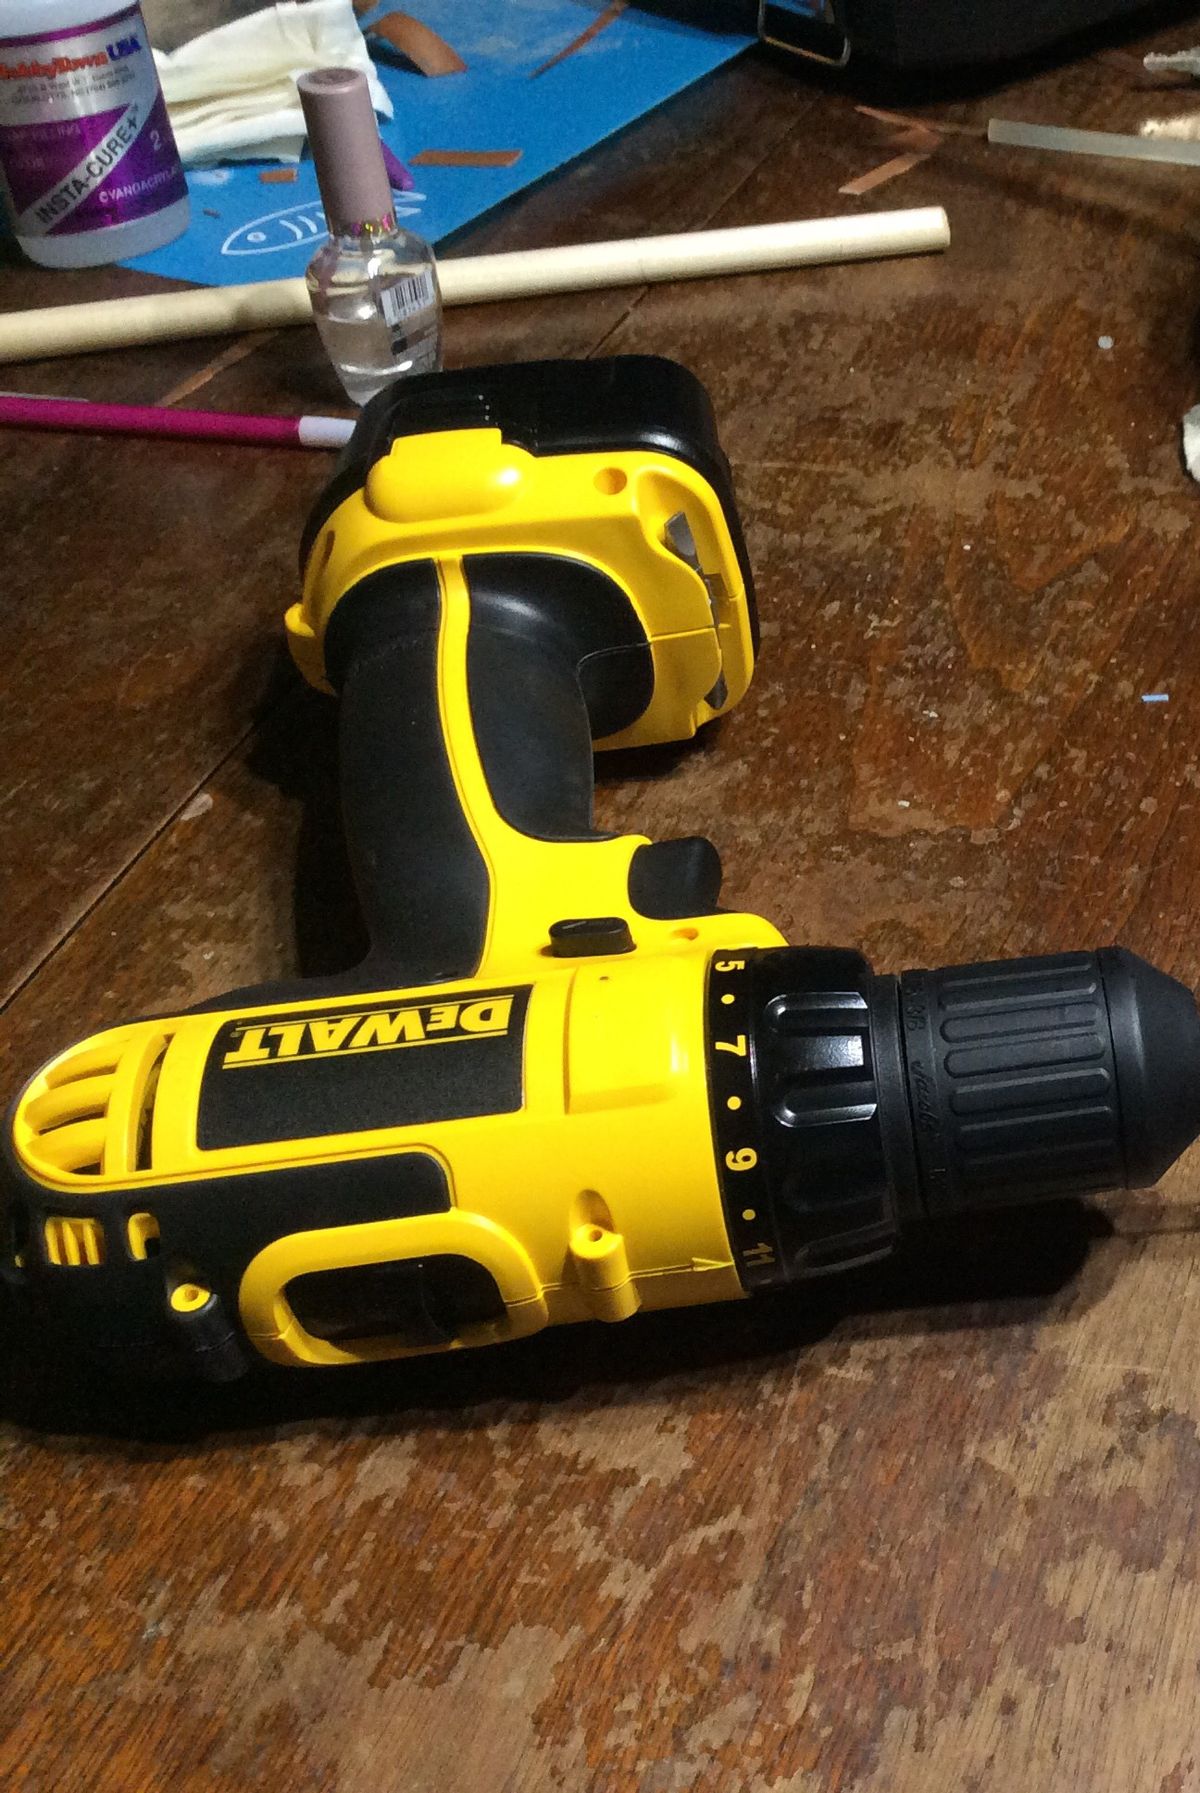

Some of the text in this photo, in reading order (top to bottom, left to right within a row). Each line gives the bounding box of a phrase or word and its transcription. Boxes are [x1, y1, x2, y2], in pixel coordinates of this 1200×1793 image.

[714, 959, 746, 973] 5
[223, 998, 515, 1064] DEWALT
[715, 1034, 747, 1058] 7
[725, 1146, 758, 1172] 9
[742, 1241, 776, 1268] 11
